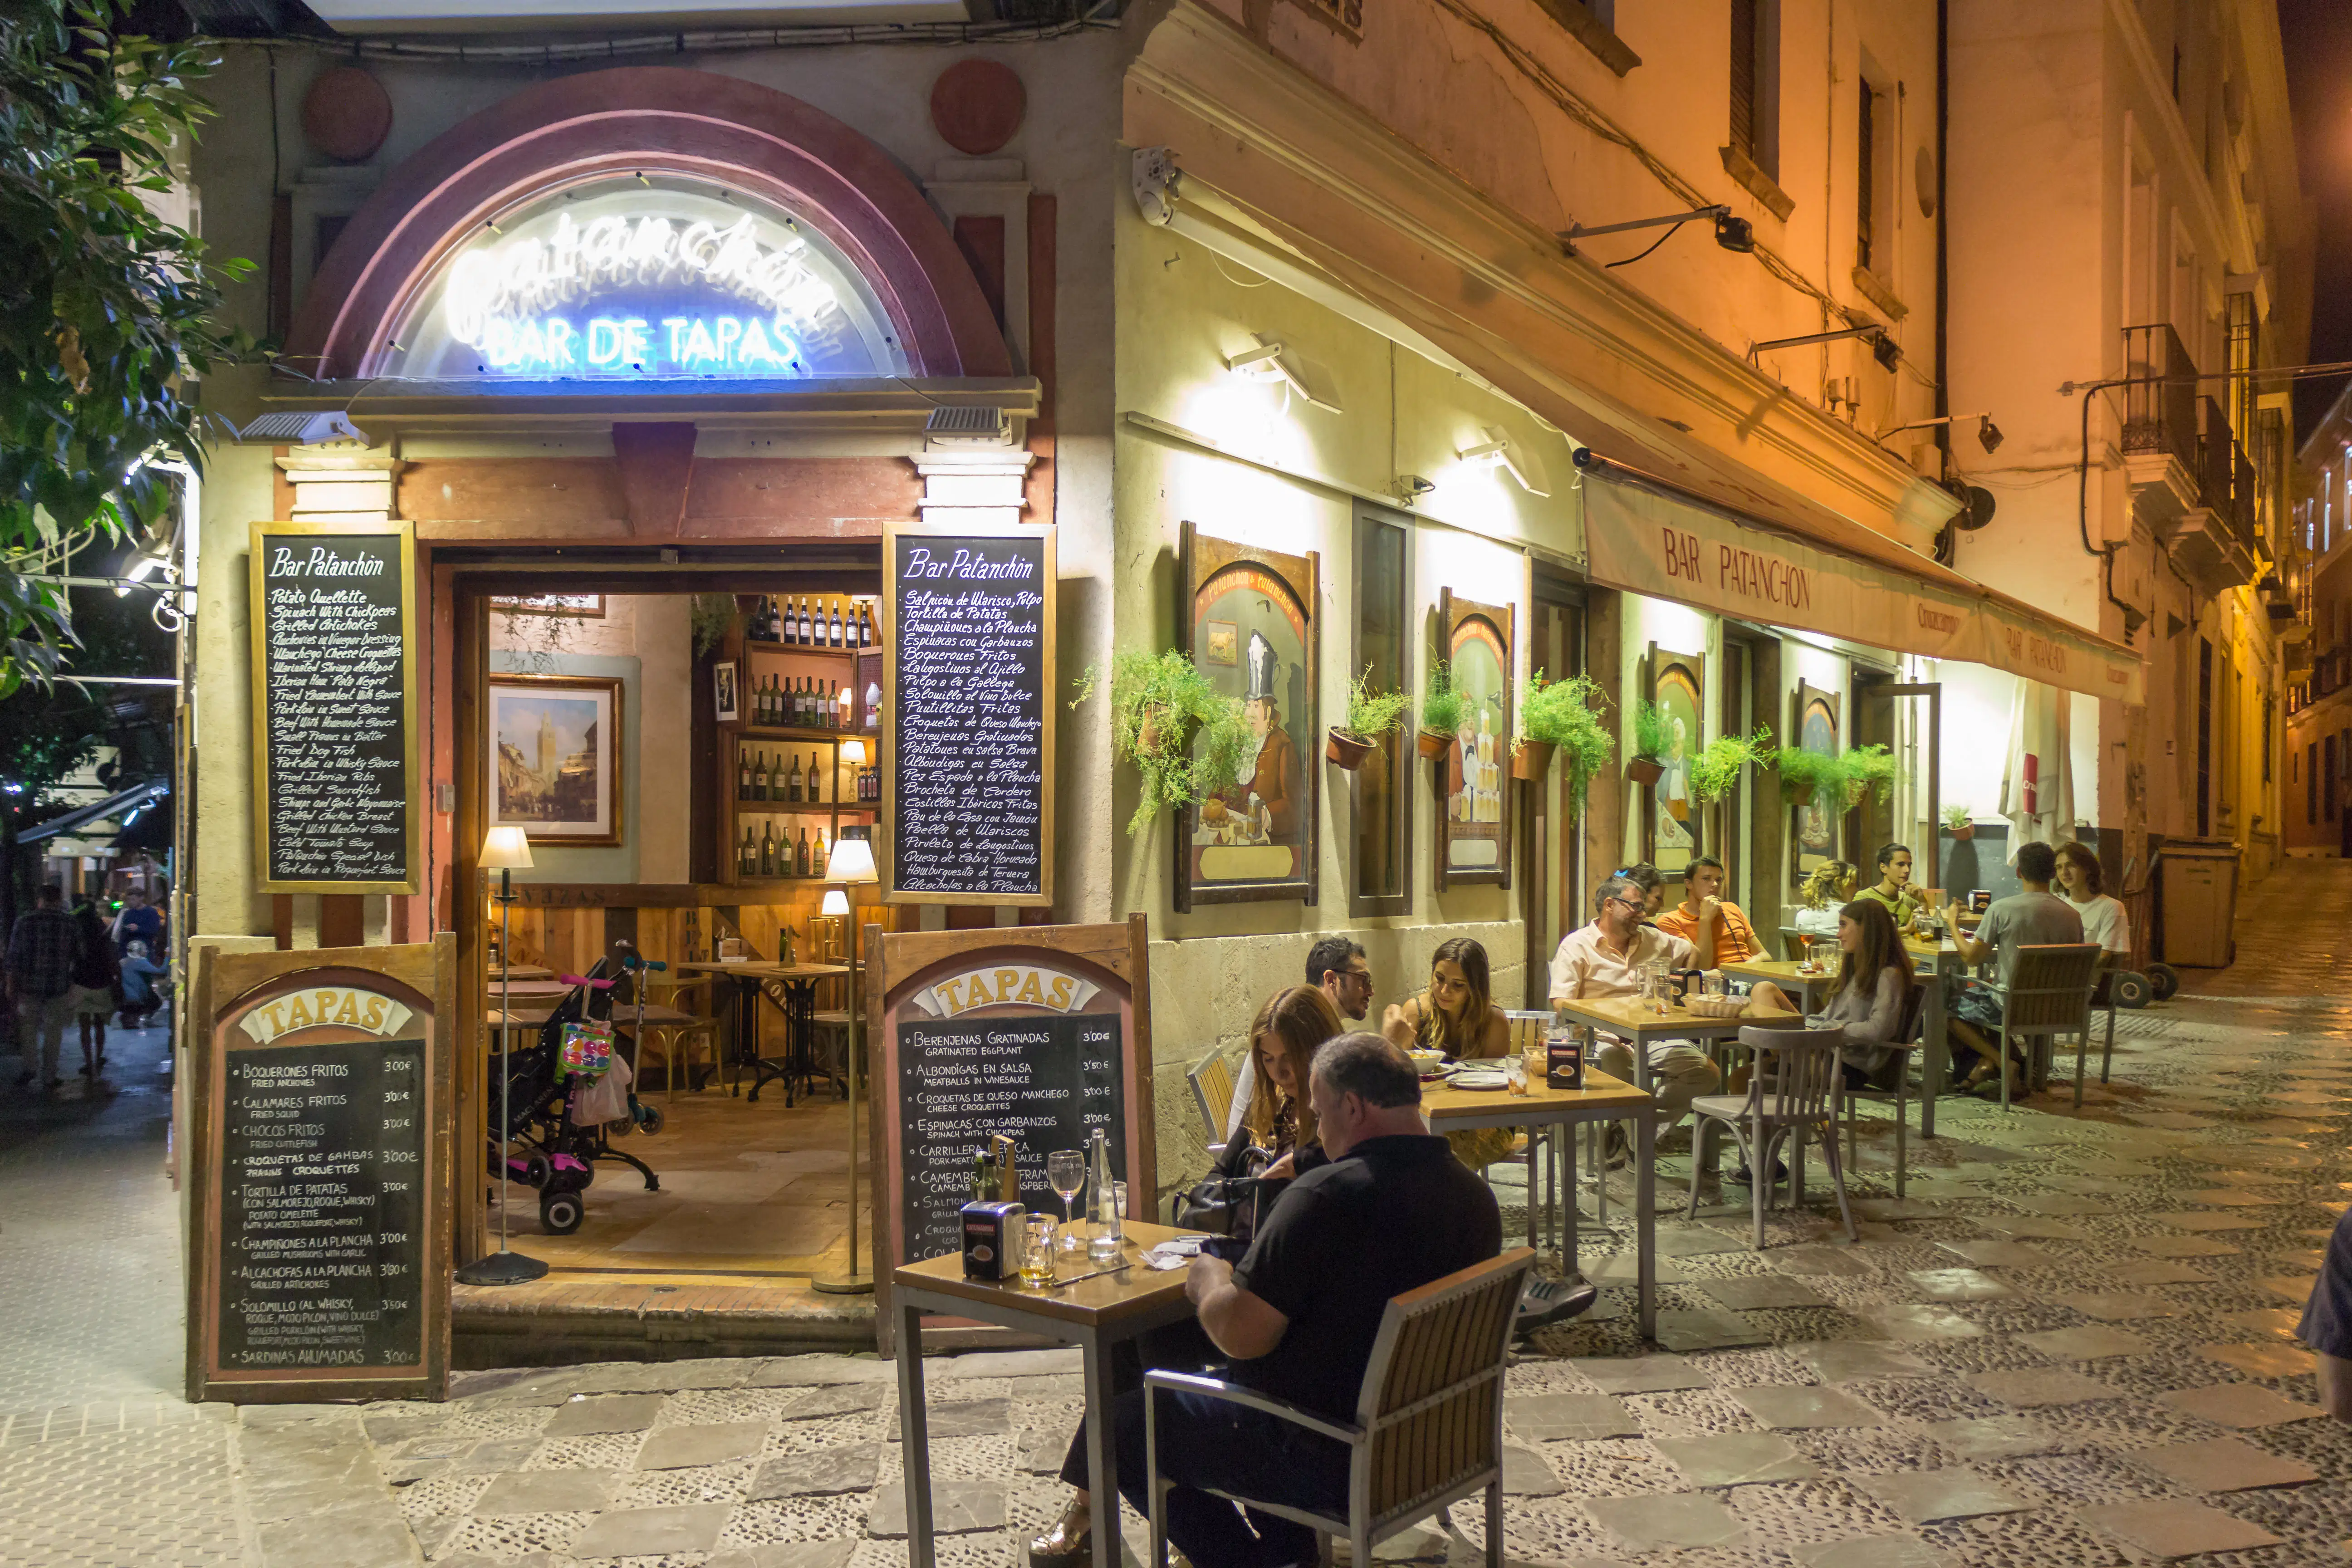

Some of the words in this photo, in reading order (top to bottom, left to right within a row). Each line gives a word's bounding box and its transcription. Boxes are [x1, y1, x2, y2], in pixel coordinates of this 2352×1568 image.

[484, 316, 574, 363] BAR
[588, 318, 649, 363] DE
[662, 317, 798, 363] TAPAS
[268, 547, 305, 577] Bar
[904, 549, 948, 578] Bar
[1663, 527, 1702, 583] BAR
[1719, 544, 1810, 611] PATANCHON
[272, 589, 306, 604] Potato
[1207, 570, 1249, 602] Patanchon
[1250, 575, 1255, 583] &
[1257, 573, 1293, 615] Patanchon
[956, 592, 968, 606] de
[1013, 591, 1042, 609] Pulpo
[319, 606, 343, 617] With
[905, 606, 947, 619] Tortilla
[951, 608, 963, 619] de
[966, 608, 1007, 619] Patatas
[272, 618, 318, 631] Grilled
[983, 622, 993, 633] la
[995, 620, 1037, 633] Plancha
[980, 650, 1016, 661] Fritos
[904, 675, 937, 691] Pulpo
[951, 676, 962, 687] la
[963, 676, 1014, 692] Gallega
[903, 715, 960, 731] Croquetas
[965, 715, 976, 726] de
[981, 717, 1007, 728] Queso
[275, 744, 306, 755] Fried
[309, 744, 330, 759] Dog
[333, 745, 356, 755] Fish
[277, 771, 305, 781] Fried
[352, 772, 375, 781] Ribs
[903, 769, 926, 781] Pez
[929, 770, 974, 784] Espada
[987, 772, 997, 782] la
[1000, 770, 1041, 783] Plancha
[278, 784, 323, 794] Grilled
[325, 784, 381, 798] Swordfish
[904, 782, 955, 795] Brocheta
[962, 784, 977, 795] de
[984, 784, 1032, 797] Cordero
[905, 797, 956, 807] Costillas
[1005, 799, 1038, 809] Fritas
[277, 823, 305, 837] Beef
[306, 824, 327, 833] With
[370, 824, 400, 834] Sauce
[905, 822, 949, 834] Paella
[956, 824, 969, 835] de
[278, 837, 305, 847] Cold
[307, 837, 348, 848] Tomato
[349, 838, 374, 850] Soup
[904, 851, 939, 862] Queso
[941, 851, 955, 862] de
[959, 853, 989, 862] Cabra
[903, 878, 962, 891] Alcachofas
[976, 881, 988, 891] la
[991, 881, 1038, 892] Plancha
[937, 969, 1074, 1015] TAPAS
[261, 991, 389, 1037] TAPAS
[914, 1032, 981, 1047] BERENJENAS
[988, 1031, 1049, 1044] GRATINADAS
[926, 1047, 977, 1056] GRATINATED
[981, 1046, 1023, 1055] EGGPLANT
[243, 1063, 308, 1078] BOQUERONES
[312, 1064, 349, 1077] FRITOS
[916, 1063, 979, 1076] ALBONDIGAS
[984, 1064, 996, 1073] EN
[1000, 1063, 1032, 1073] SALSA
[924, 1076, 970, 1086] MEATBALLS
[985, 1075, 1030, 1084] WINESAUCE
[243, 1096, 304, 1108] CALAMARES
[309, 1095, 347, 1106] FRITOS
[917, 1092, 971, 1105] CROQUETAS
[974, 1093, 985, 1102] DE
[988, 1091, 1018, 1101] QUESO
[1021, 1090, 1069, 1099] MANCHEGO
[927, 1104, 957, 1113] CHEESE
[961, 1103, 1010, 1112] CROQUETTES
[976, 1118, 995, 1128] CON
[997, 1116, 1057, 1127] GARBANZOS
[242, 1125, 285, 1137] CHOCOS
[289, 1124, 325, 1135] FRITOS
[927, 1130, 960, 1139] SPINACH
[963, 1129, 983, 1137] WITH
[985, 1128, 1025, 1137] CHICKPEAS
[250, 1141, 273, 1149] FRIED
[243, 1153, 304, 1165] CROQUETAS
[309, 1153, 323, 1161] DE
[328, 1151, 374, 1161] GAMBAS
[383, 1151, 419, 1163] 3'00€
[1014, 1153, 1043, 1162] SAUCE
[293, 1164, 360, 1175] CROQUETTES
[241, 1184, 287, 1196] TORTILLA
[289, 1186, 302, 1195] DE
[306, 1184, 348, 1195] PATATAS
[923, 1196, 966, 1208] SALMON
[249, 1210, 277, 1220] POTATO
[309, 1238, 317, 1248] A
[318, 1237, 328, 1247] LA
[330, 1234, 373, 1247] PLANCHA
[241, 1350, 295, 1363] SARDINAS
[298, 1349, 365, 1364] AHUMADAS
